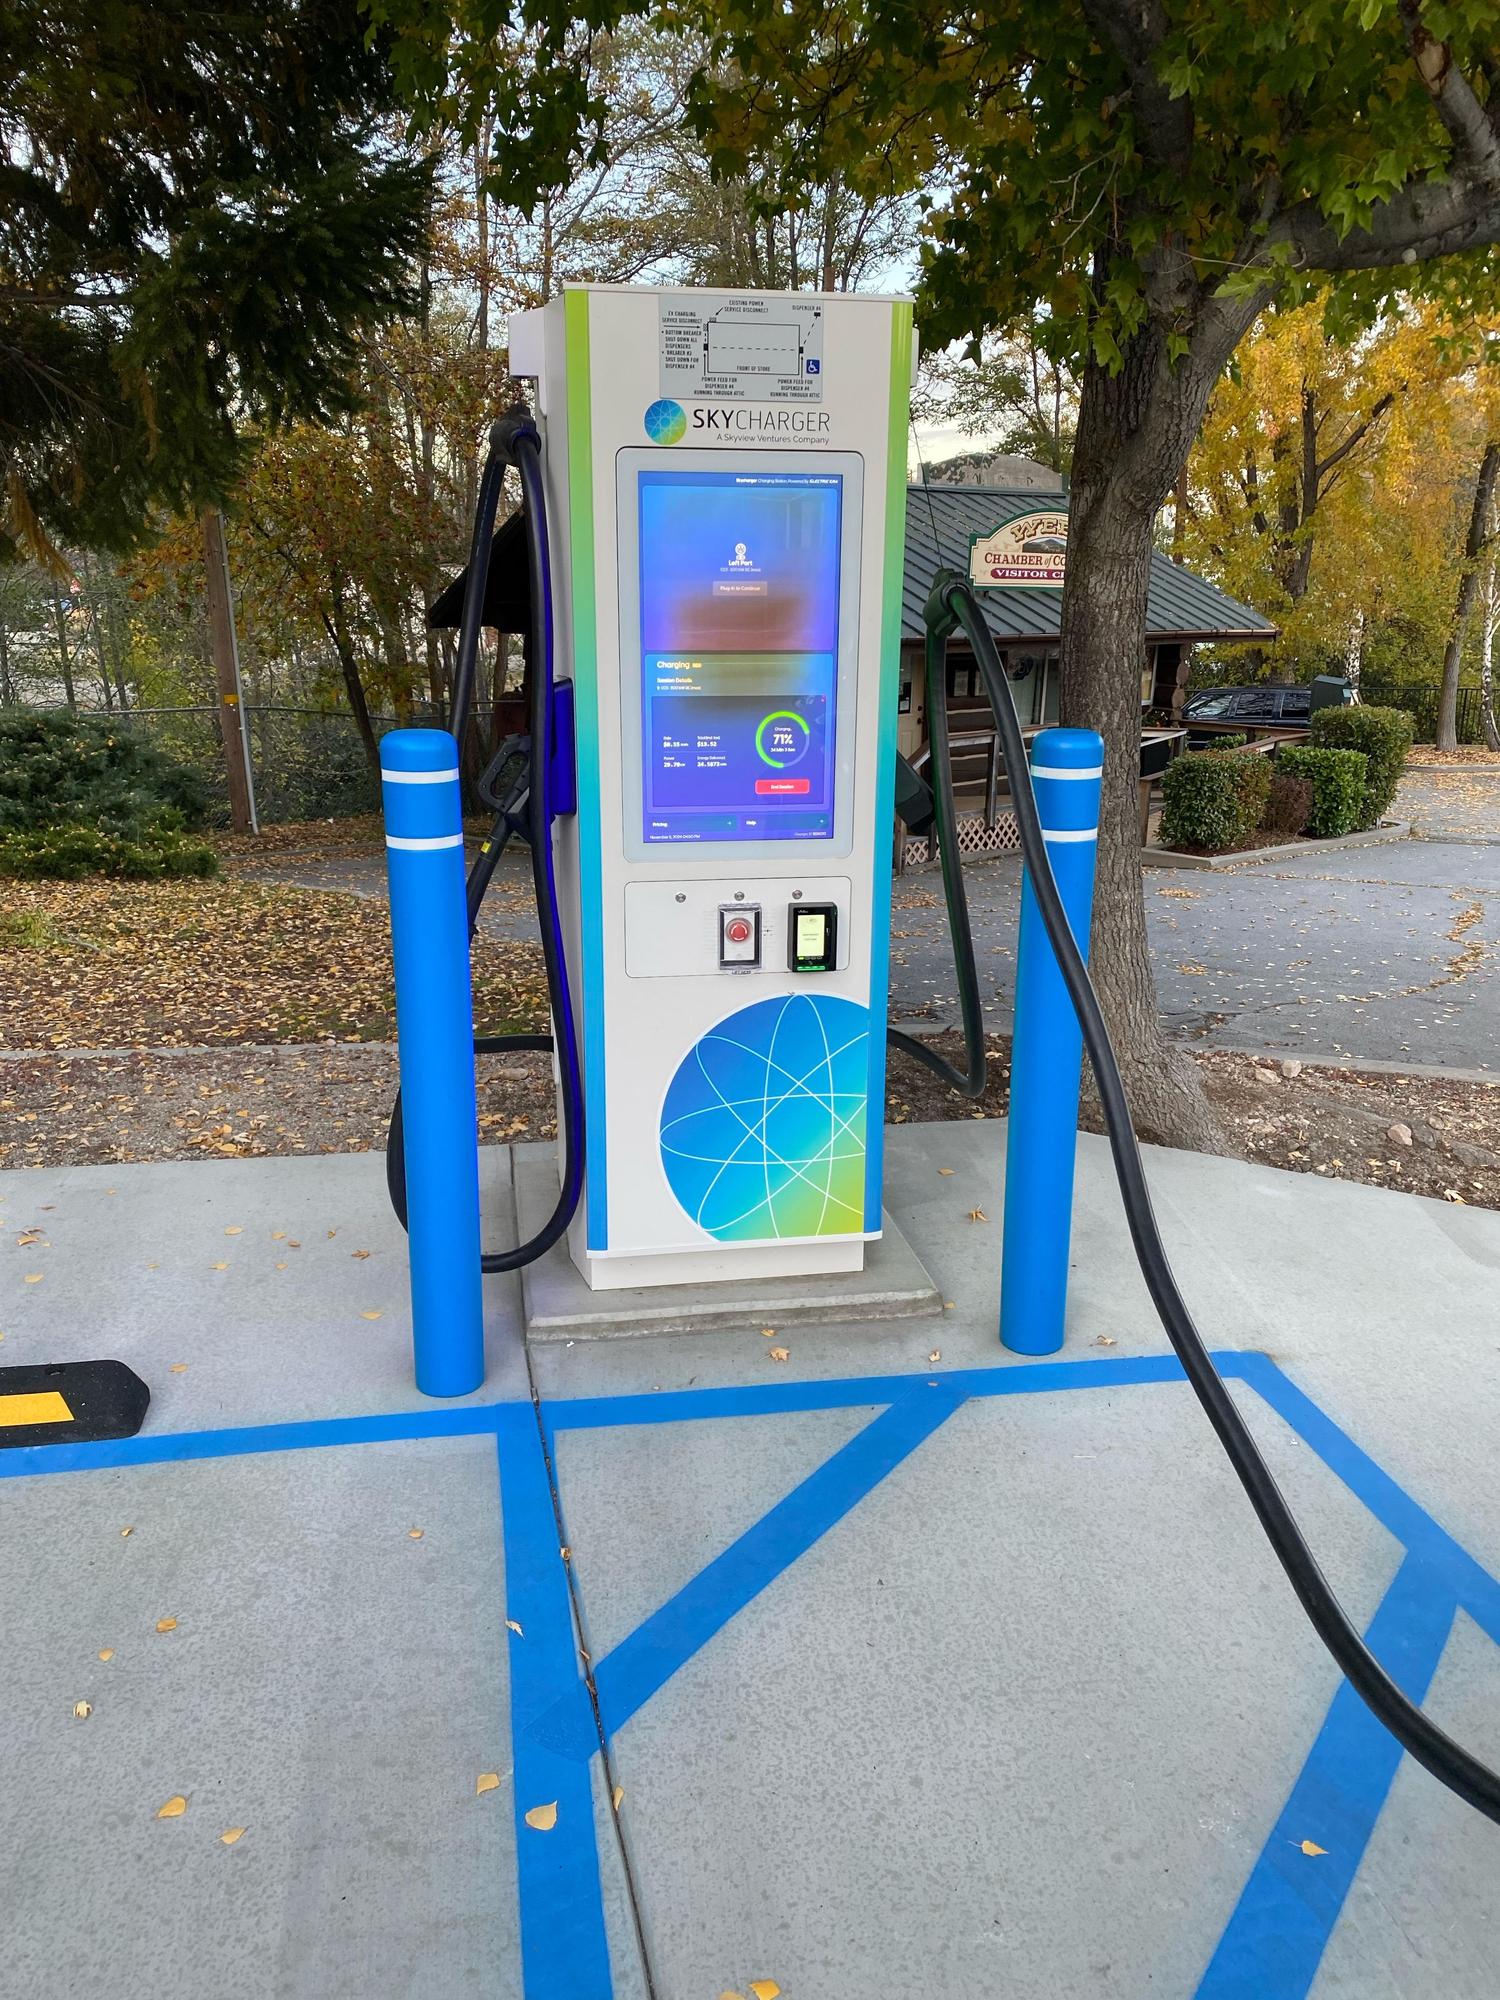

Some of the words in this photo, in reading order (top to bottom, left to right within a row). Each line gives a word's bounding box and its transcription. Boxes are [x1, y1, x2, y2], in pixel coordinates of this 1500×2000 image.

[693, 409, 830, 432] SKYCHARGER
[724, 434, 756, 443] Skyview
[757, 434, 791, 443] Ventures
[793, 435, 829, 445] Company
[985, 552, 1043, 566] CHAMBER
[1044, 555, 1053, 568] of
[996, 569, 1048, 578] VISITOR
[656, 661, 690, 670] Charging
[773, 734, 793, 744] 71%
